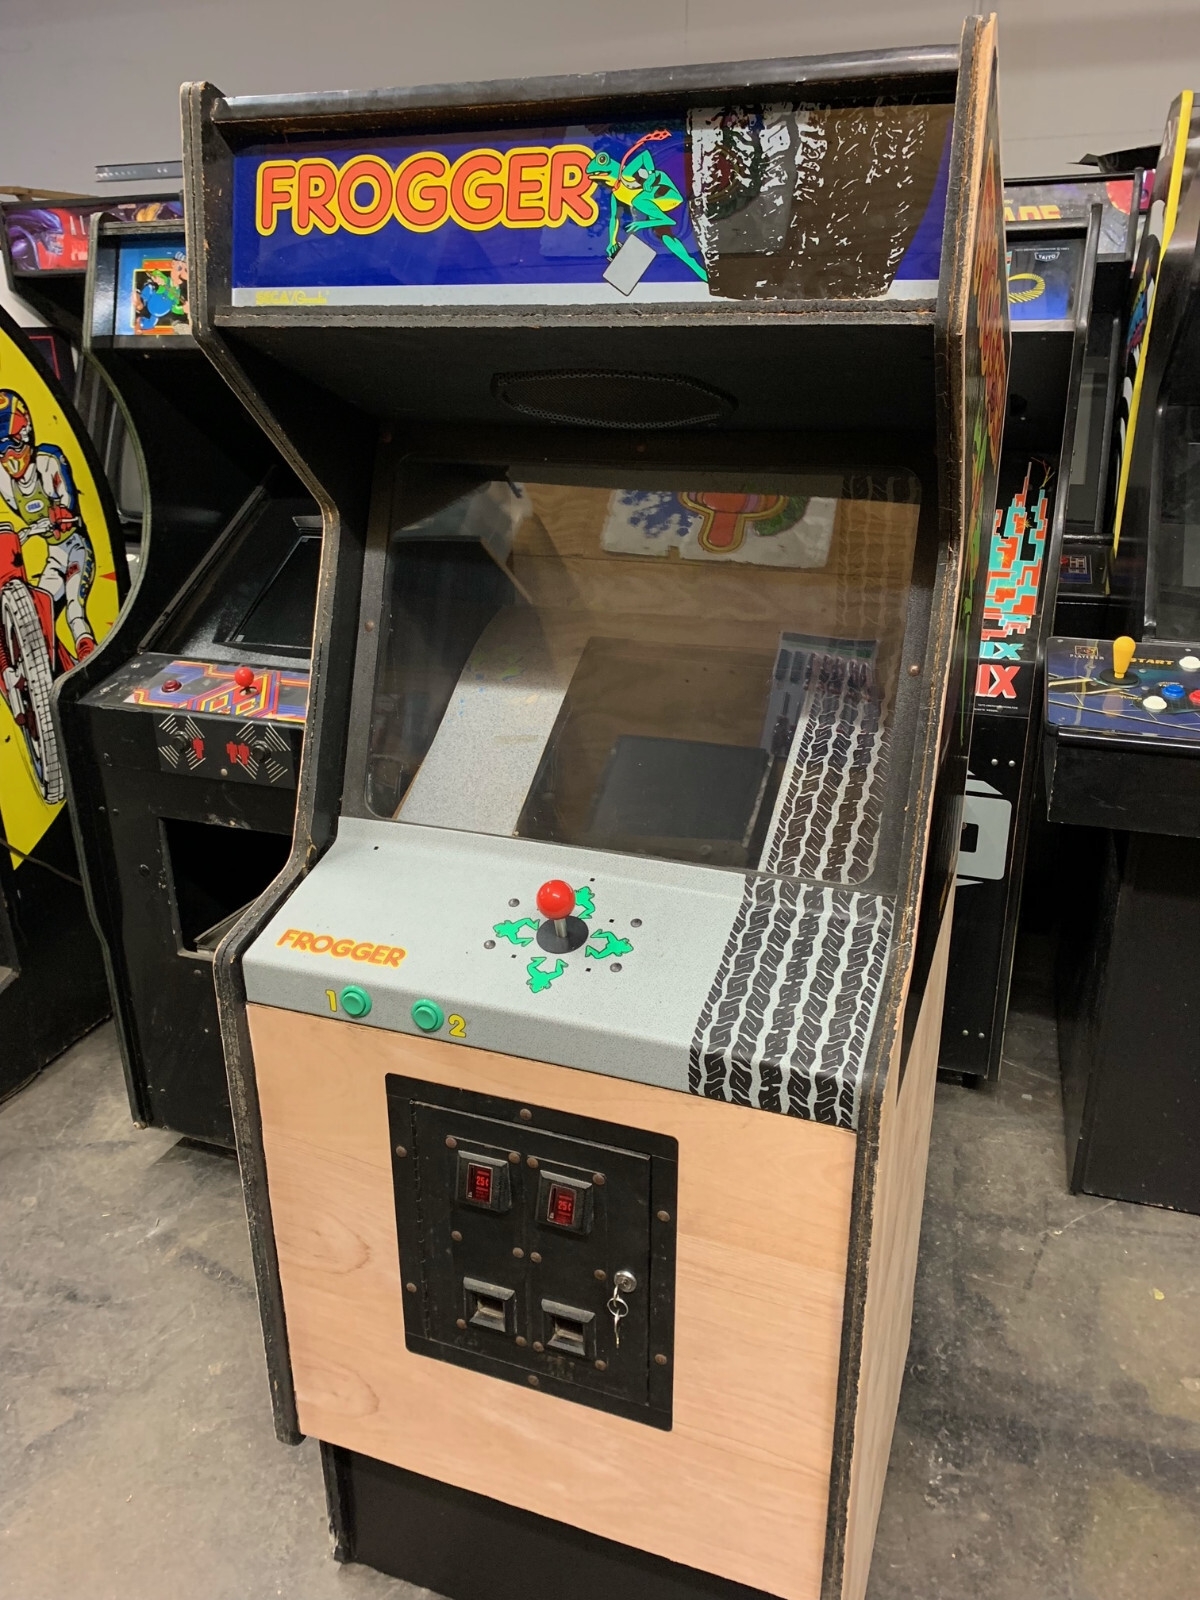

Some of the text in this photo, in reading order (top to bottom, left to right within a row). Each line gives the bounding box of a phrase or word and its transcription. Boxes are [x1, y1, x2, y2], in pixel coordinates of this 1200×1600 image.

[255, 144, 599, 236] FROGGER
[276, 928, 408, 969] FROGGER
[325, 989, 338, 1012] 1
[448, 1013, 467, 1038] 2
